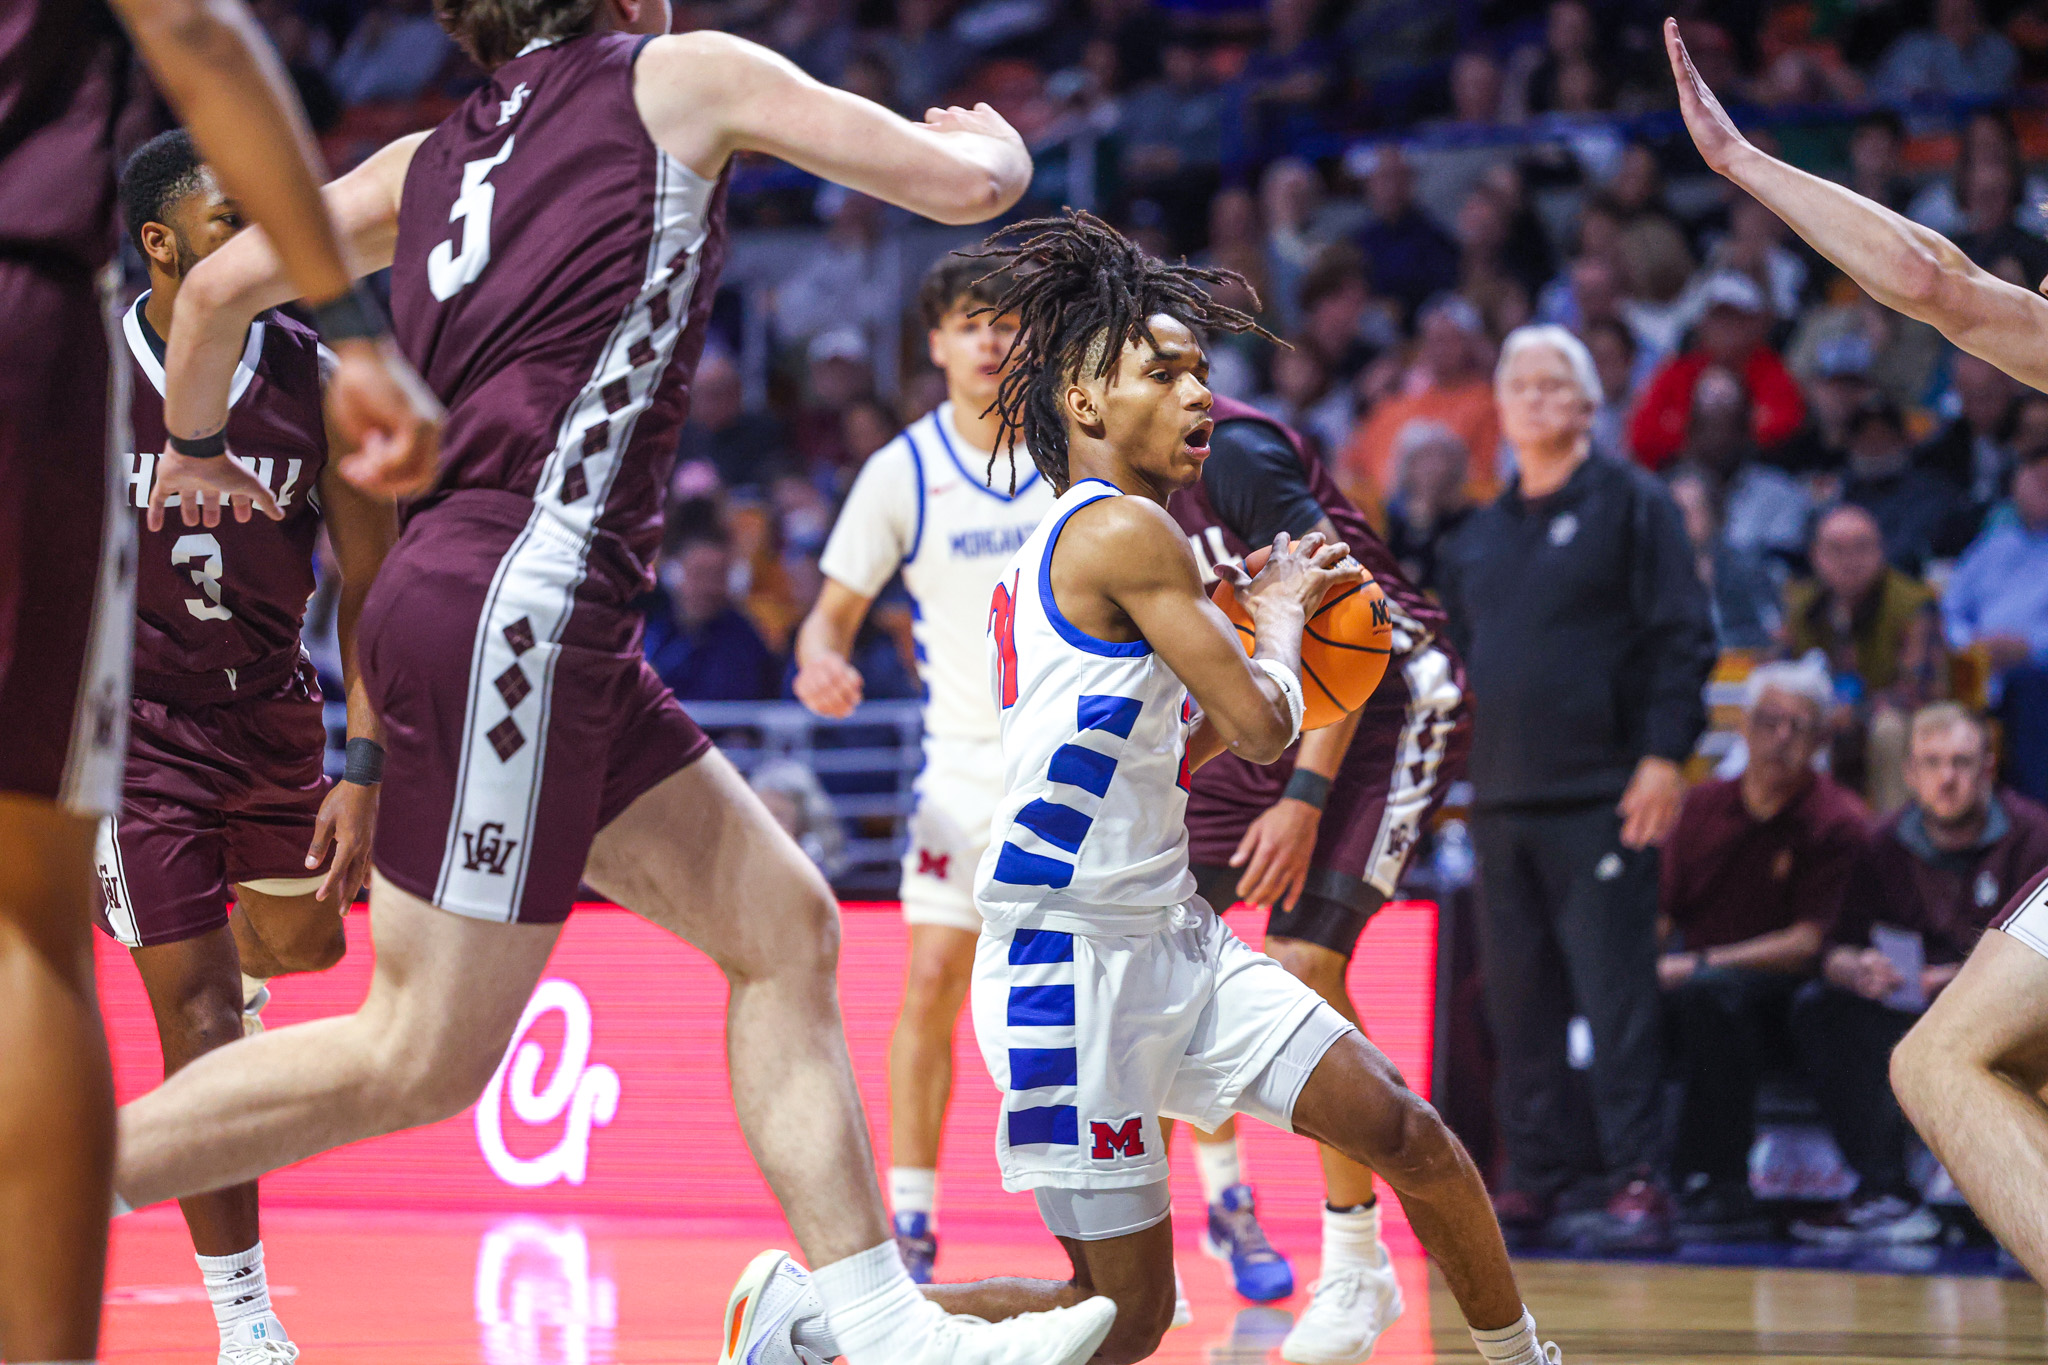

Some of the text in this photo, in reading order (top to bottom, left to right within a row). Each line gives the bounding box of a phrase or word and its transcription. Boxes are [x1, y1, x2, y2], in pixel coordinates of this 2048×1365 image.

[427, 133, 516, 303] 5
[171, 533, 233, 622] 3
[919, 848, 950, 880] M
[1089, 1116, 1145, 1159] M
